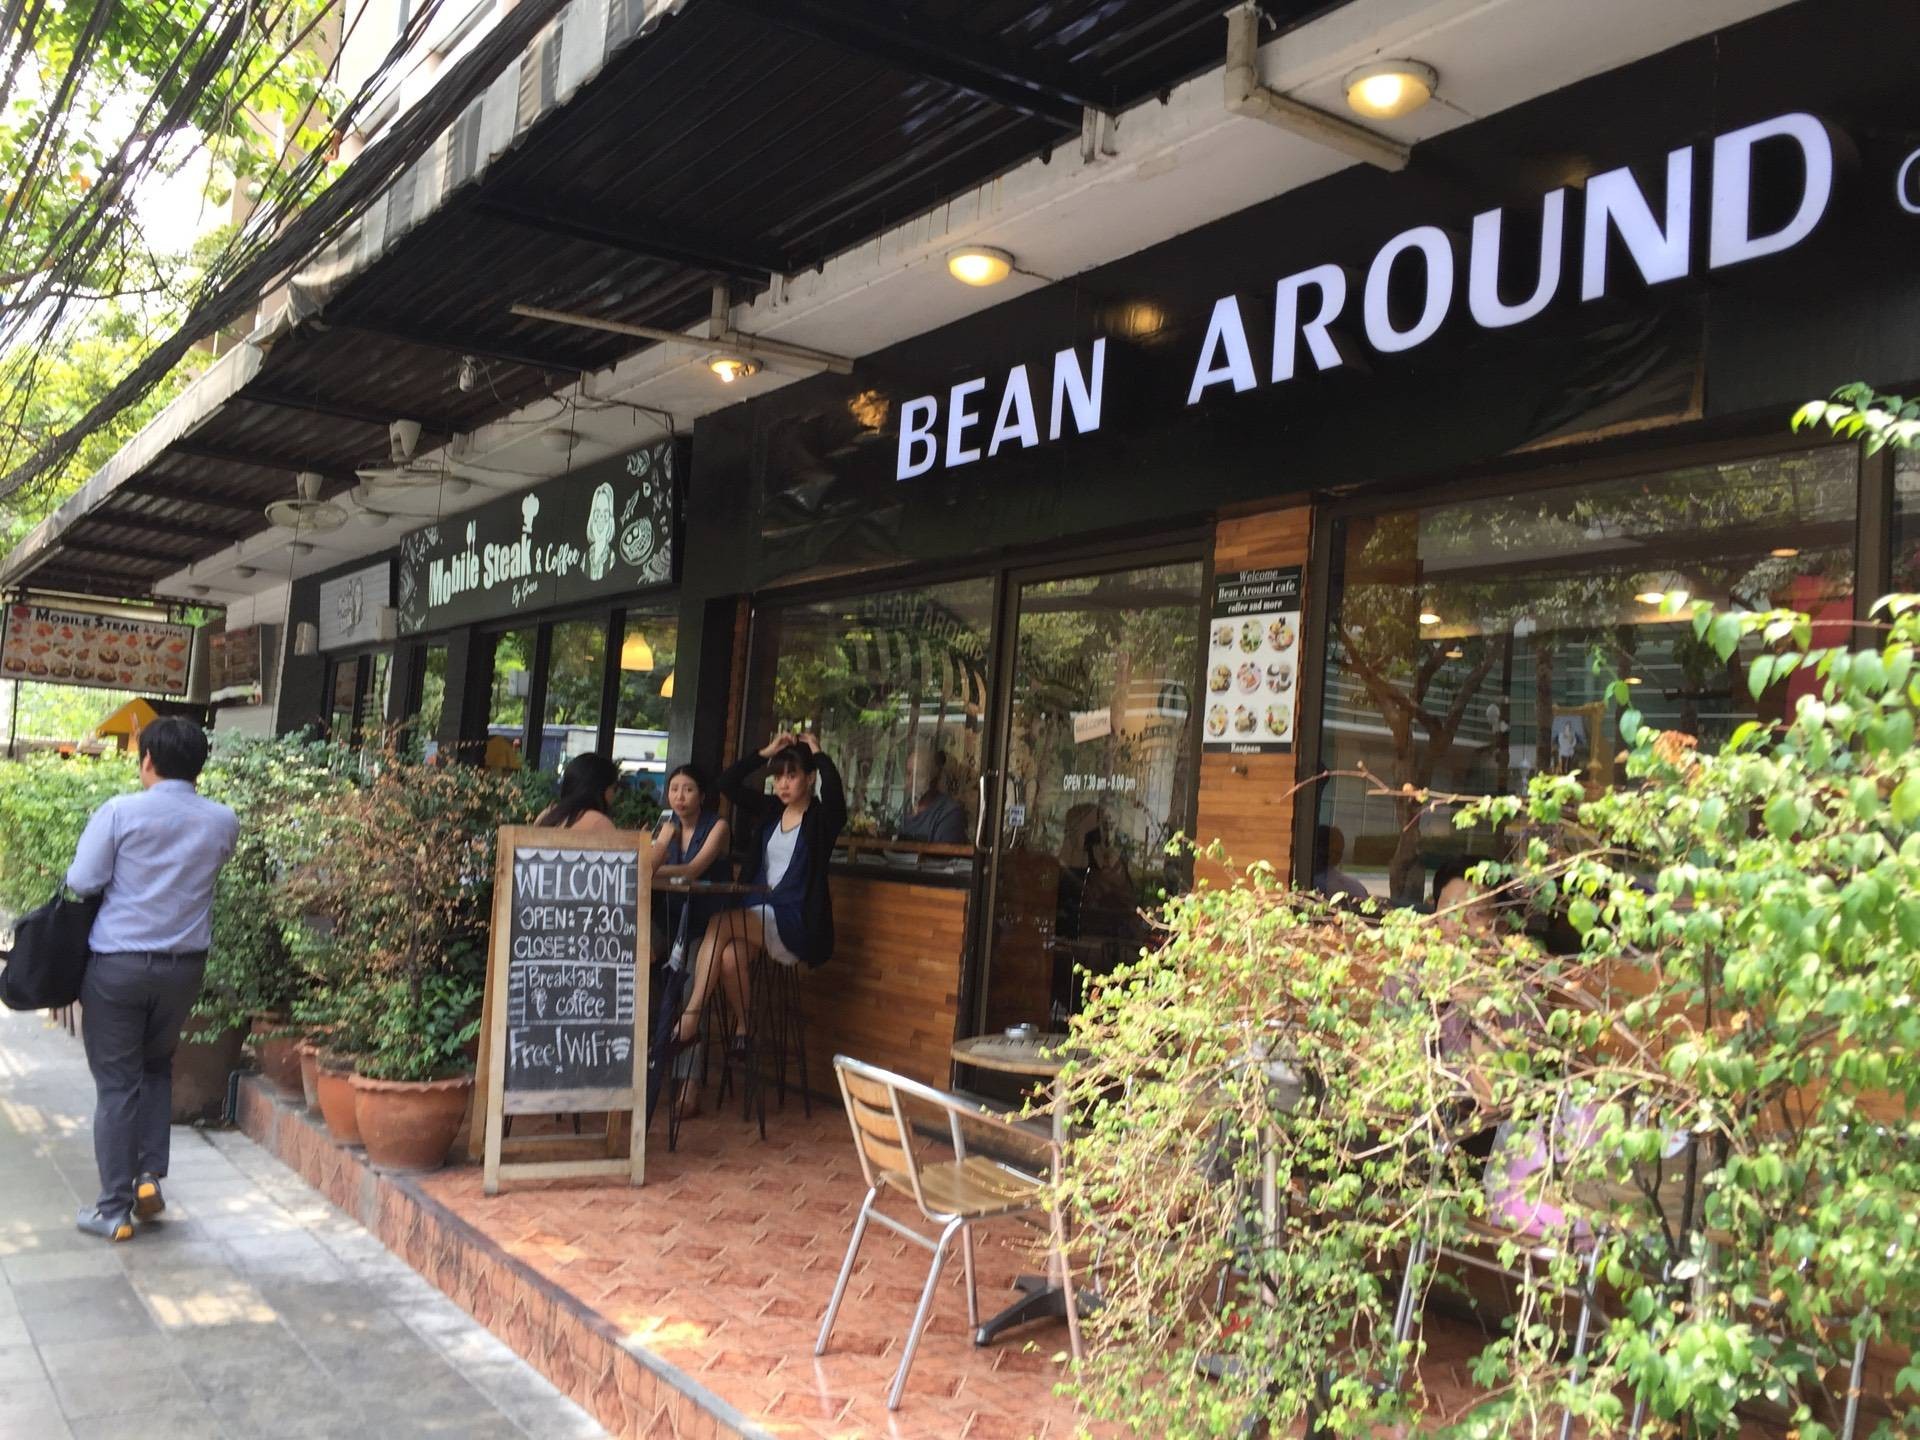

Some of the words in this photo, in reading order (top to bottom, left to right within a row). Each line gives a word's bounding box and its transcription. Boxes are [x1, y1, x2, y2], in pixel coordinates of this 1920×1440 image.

[896, 338, 1107, 481] BEAN
[1187, 114, 1833, 406] AROUND
[429, 543, 479, 608] Mobile
[483, 532, 532, 590] Steak
[536, 547, 542, 575] &
[545, 542, 580, 577] Coffee
[1240, 570, 1279, 583] Welcome
[1219, 586, 1239, 600] Bean
[1241, 581, 1274, 597] Around
[1276, 579, 1296, 593] cafe
[1249, 599, 1263, 612] and
[1263, 600, 1283, 611] more
[36, 607, 91, 628] MOBILE
[95, 614, 140, 634] STEAK
[1063, 774, 1081, 791] OPEN
[1125, 777, 1136, 793] pm
[514, 862, 637, 905] WELCOME
[528, 965, 604, 990] Breakfast
[555, 988, 606, 1018] coffee
[564, 1029, 611, 1068] WiFi
